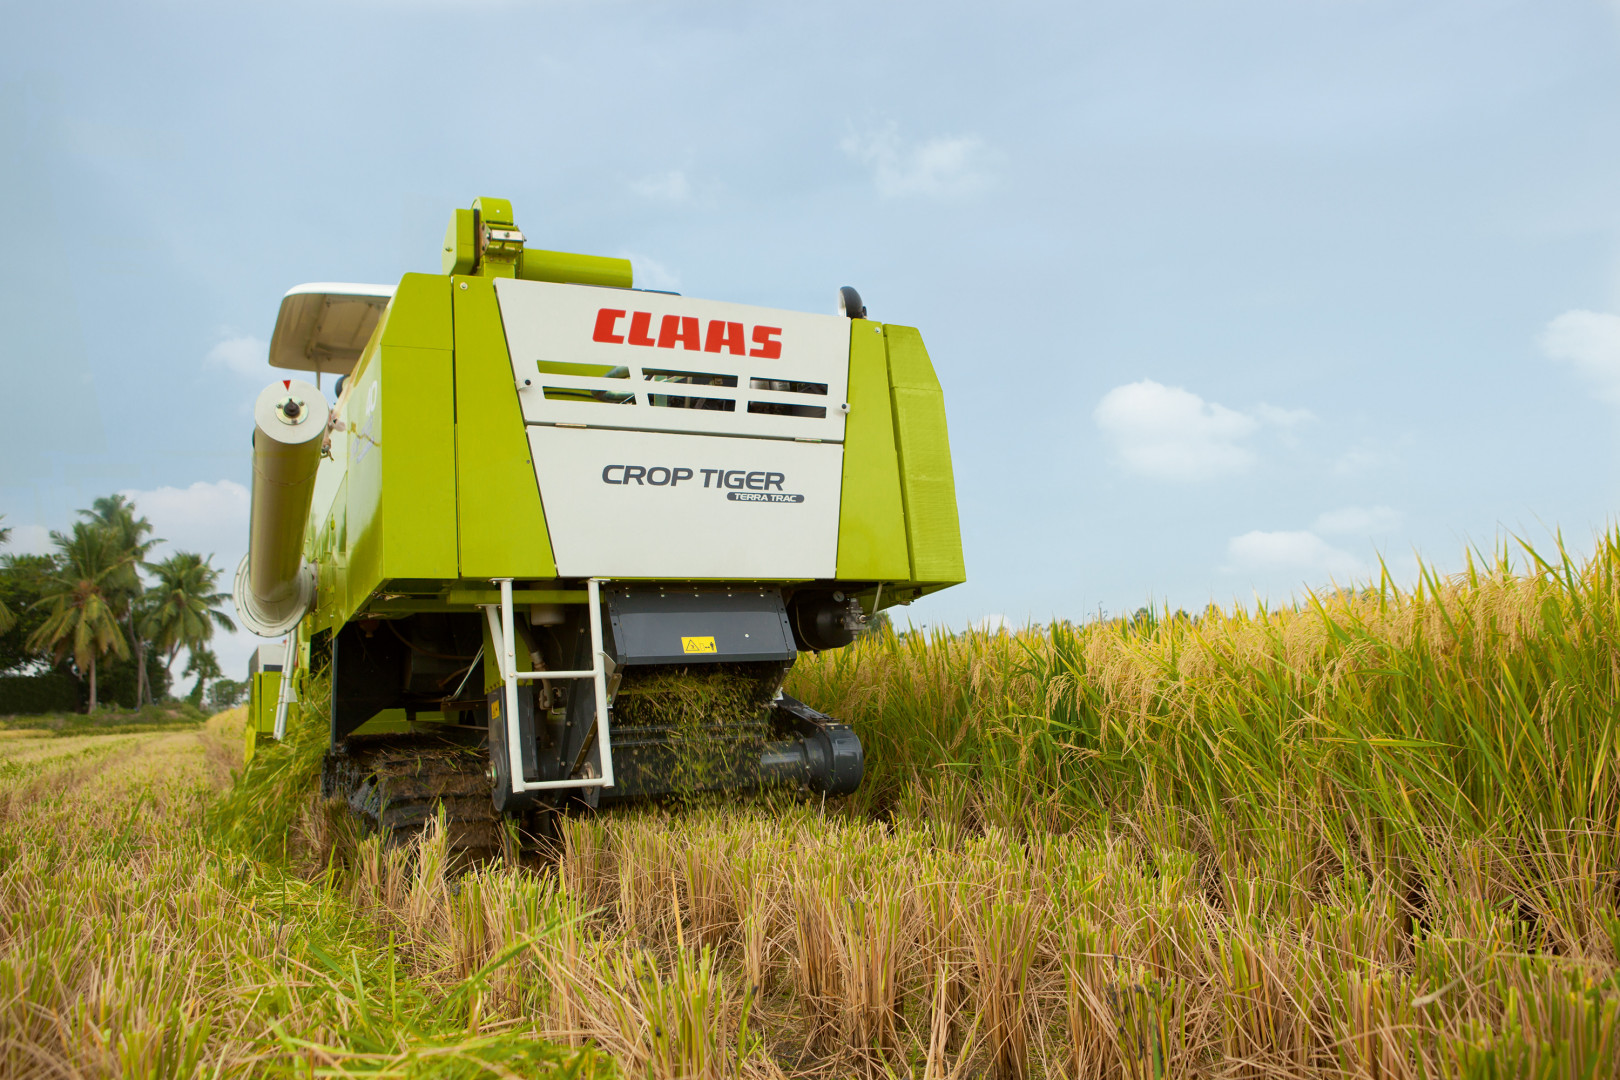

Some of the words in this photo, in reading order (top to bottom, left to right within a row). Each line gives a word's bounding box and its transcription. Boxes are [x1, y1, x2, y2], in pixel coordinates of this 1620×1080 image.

[592, 308, 782, 360] CLAAS
[602, 464, 693, 487] CROP
[699, 468, 785, 491] TIGER
[734, 492, 769, 502] TERRA
[770, 494, 797, 503] TRAC
